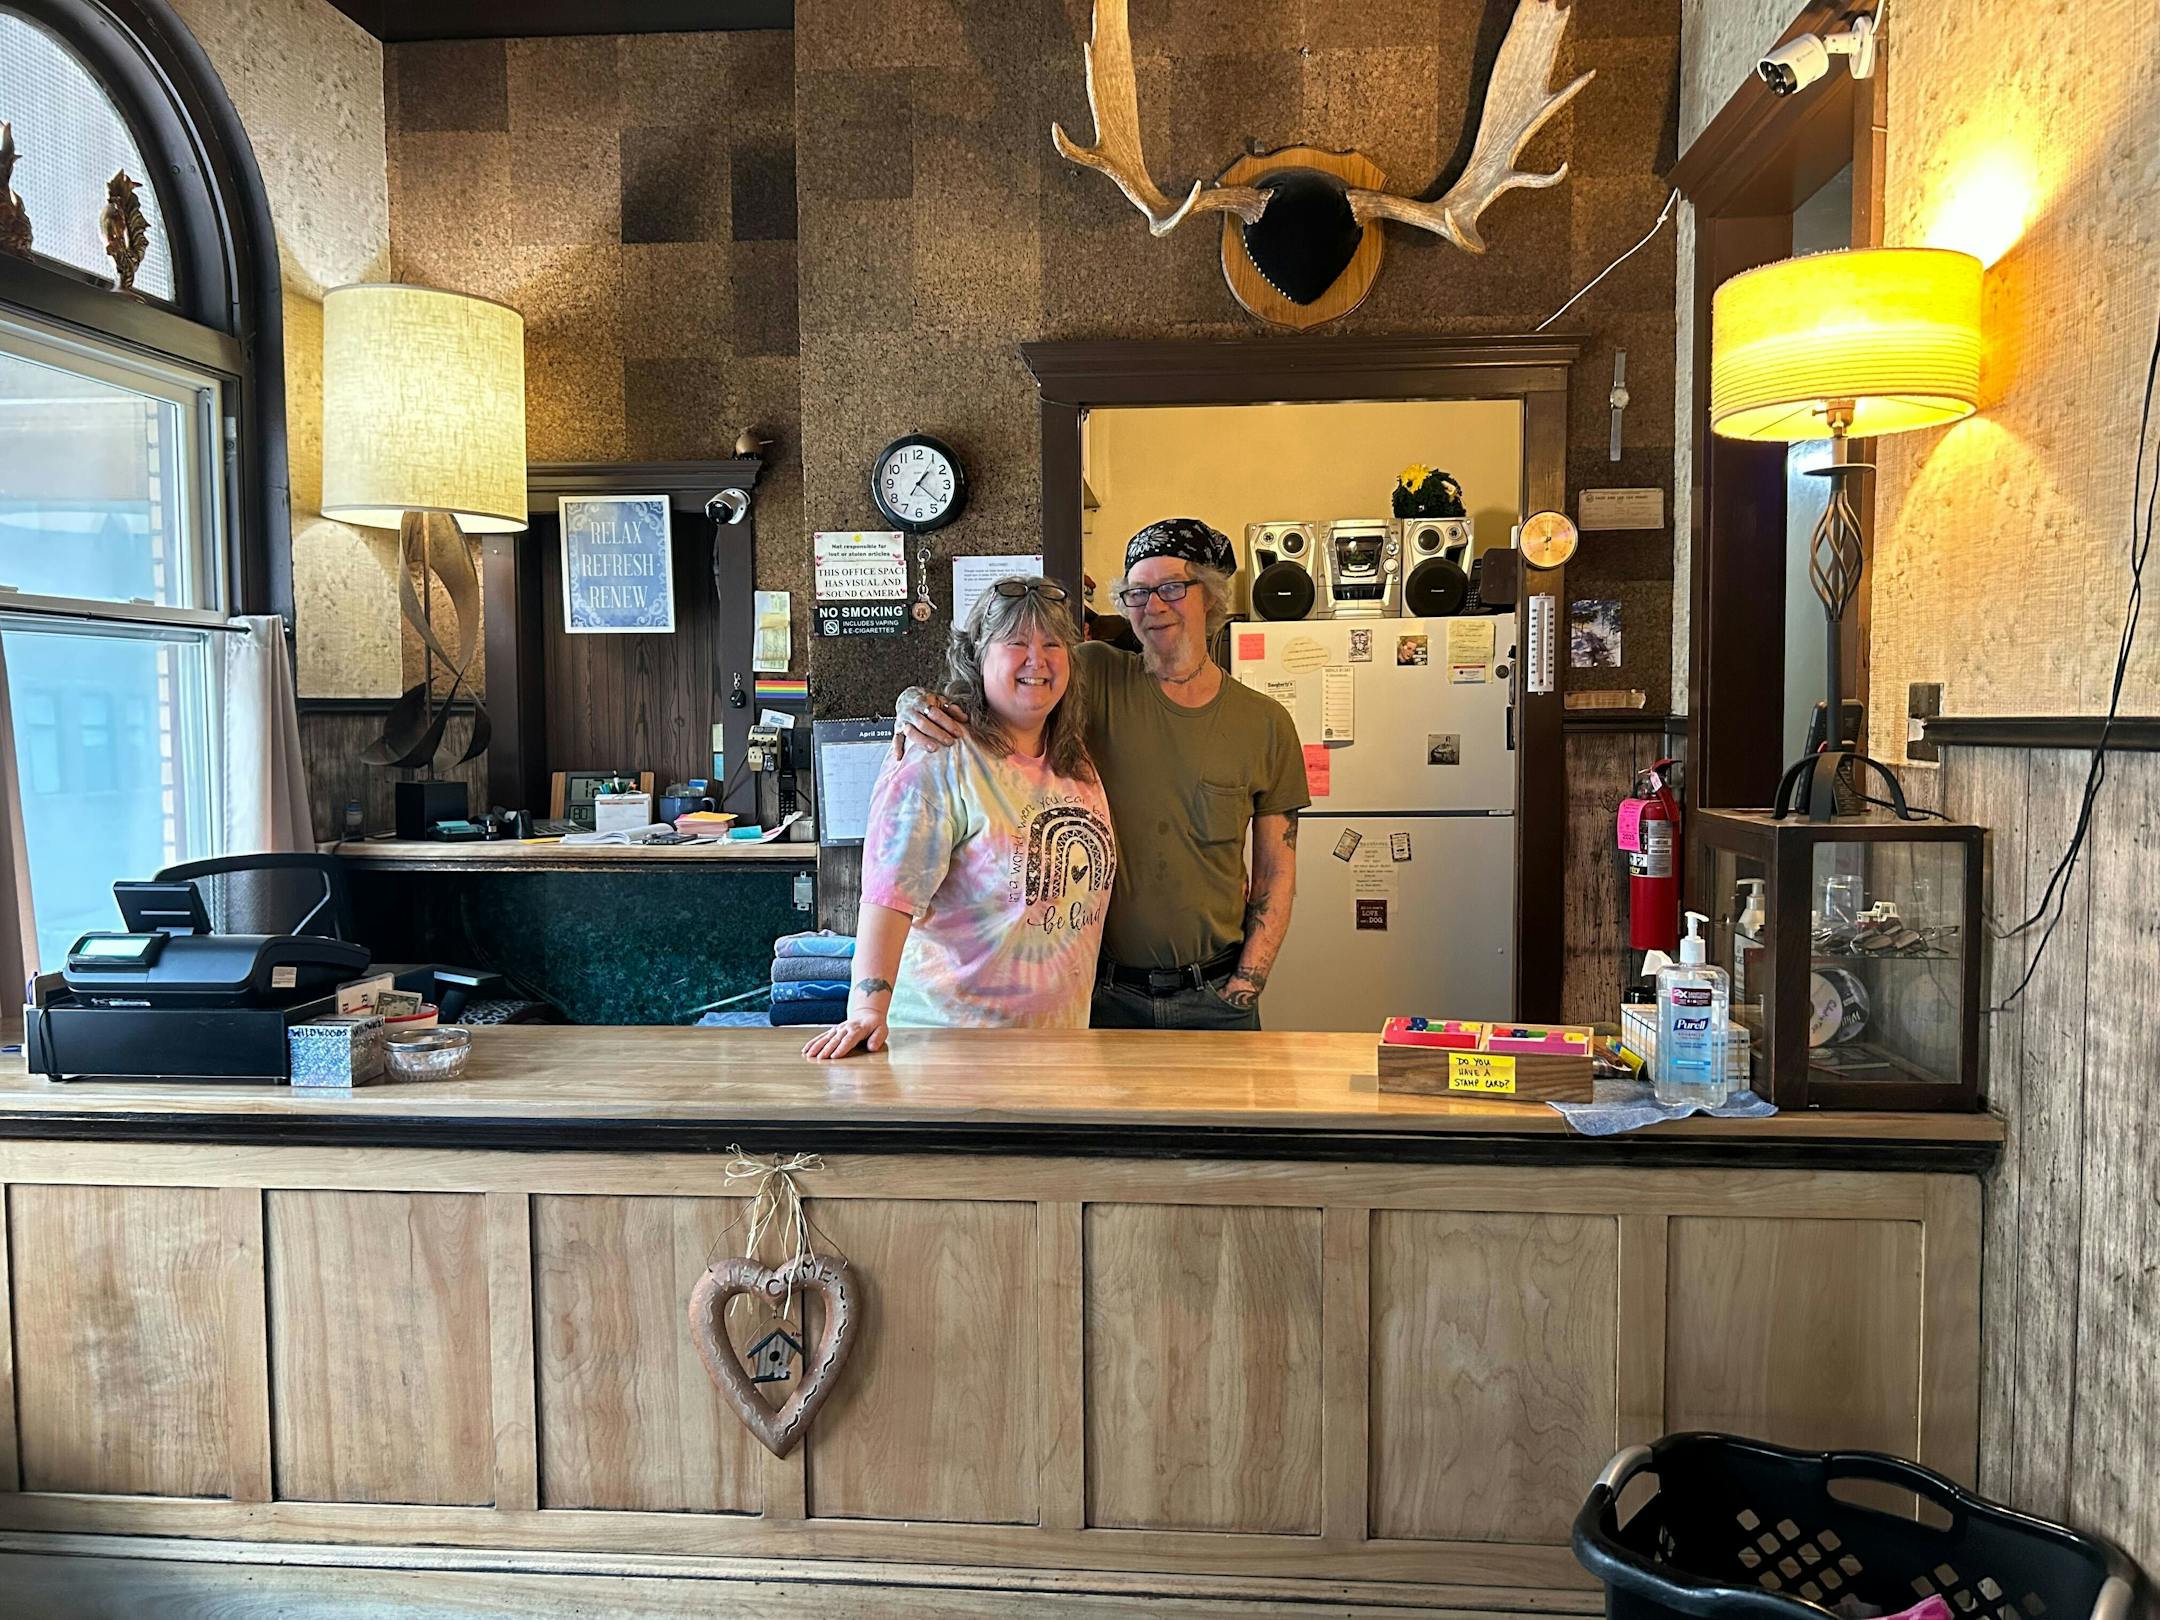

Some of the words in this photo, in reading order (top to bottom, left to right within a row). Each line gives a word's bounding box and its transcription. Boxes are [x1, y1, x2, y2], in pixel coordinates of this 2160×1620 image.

[900, 453, 908, 464] 11
[913, 449, 924, 460] 12
[889, 464, 900, 475] 10
[938, 464, 947, 475] 2
[886, 478, 894, 489] 9
[943, 479, 951, 490] 3
[890, 493, 899, 504] 8
[939, 493, 947, 504] 4
[901, 503, 909, 514] 7
[915, 507, 923, 518] 6
[929, 503, 938, 514] 5
[590, 521, 643, 545] RELAX
[582, 553, 654, 577] REFRESH
[819, 569, 840, 577] THIS
[841, 568, 876, 576] OFFICE
[846, 579, 880, 587] VISUAL
[882, 578, 901, 586] AND
[589, 585, 648, 609] RENEW
[825, 590, 857, 598] SOUND
[820, 607, 838, 618] NO
[841, 606, 903, 617] SMOKING
[859, 730, 875, 738] April
[1040, 795, 1059, 809] you
[1027, 905, 1065, 934] be
[1069, 901, 1101, 931] kind
[1456, 1057, 1470, 1066] DO
[1473, 1058, 1490, 1066] YOU
[1458, 1068, 1480, 1077] HAVE
[1484, 1068, 1491, 1077] A
[1454, 1078, 1479, 1087] STAMP
[1485, 1079, 1510, 1089] CARD?
